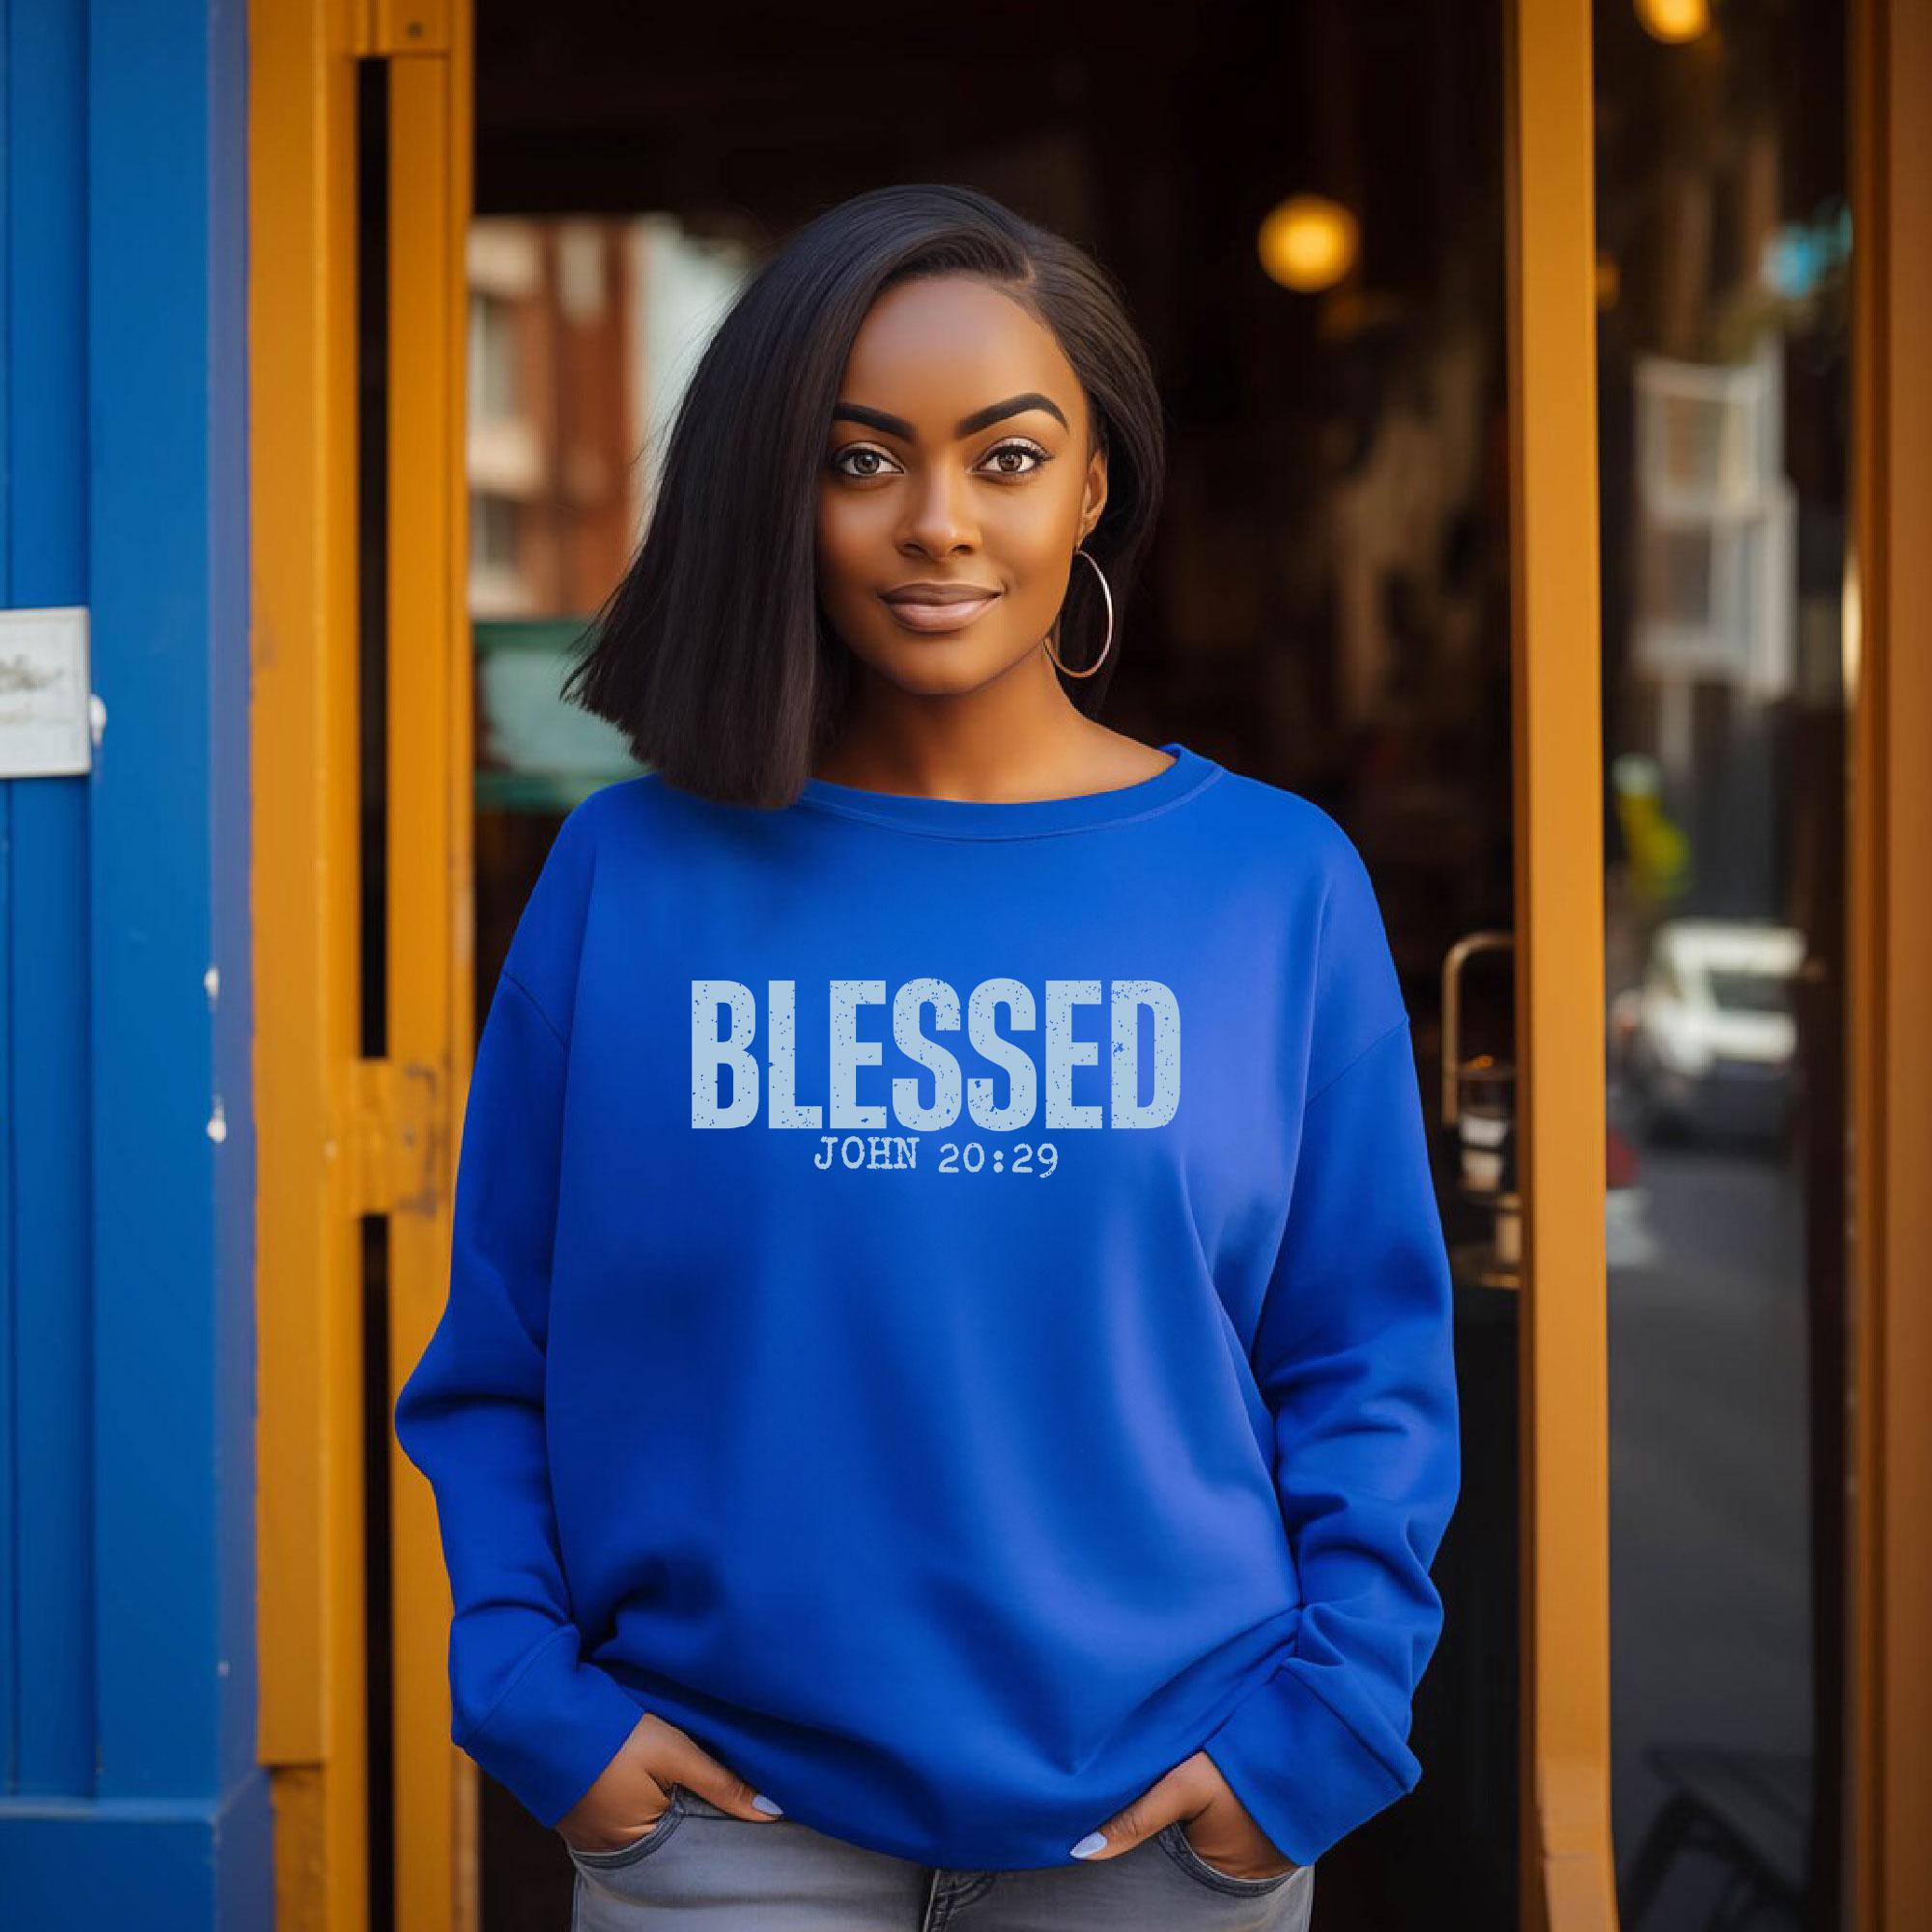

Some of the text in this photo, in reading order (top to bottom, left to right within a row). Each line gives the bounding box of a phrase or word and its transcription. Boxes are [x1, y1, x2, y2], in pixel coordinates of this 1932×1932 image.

[691, 978, 1180, 1131] BLESSED
[813, 1135, 1059, 1178] JOHN 20:29
